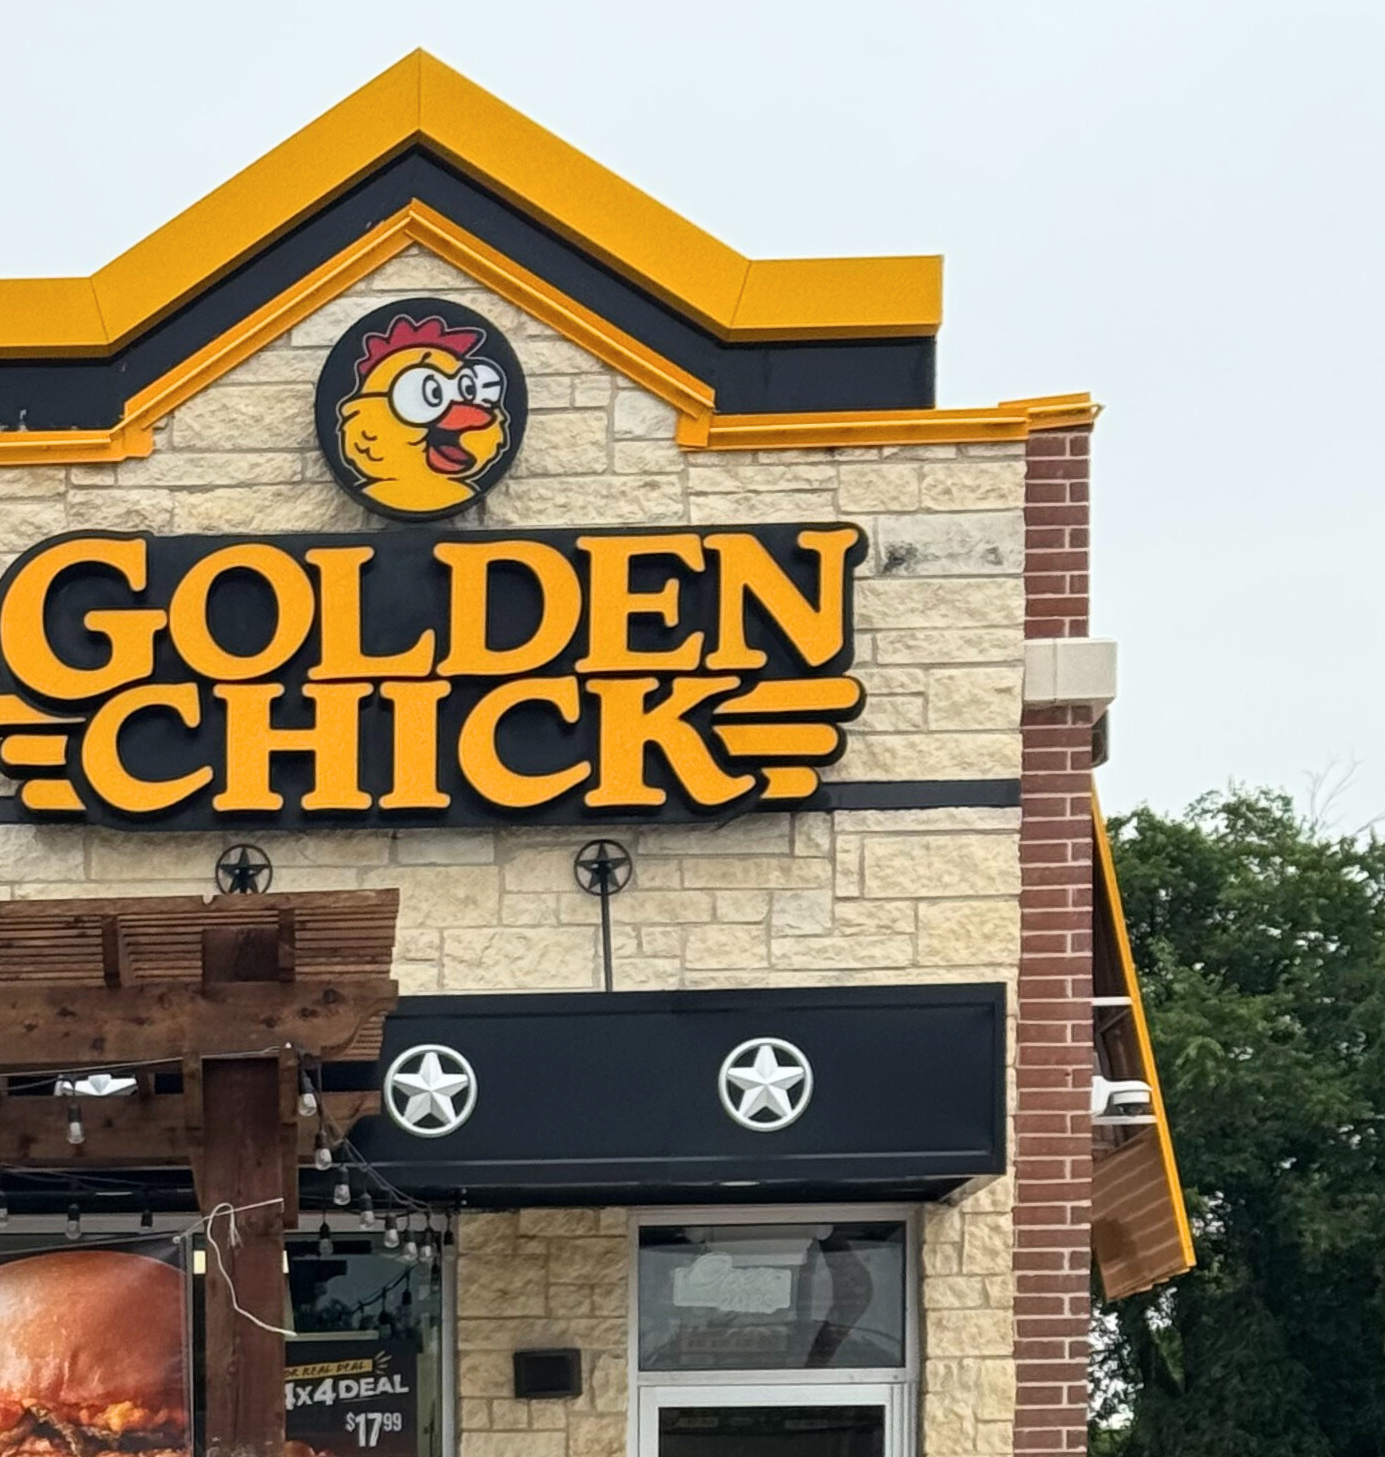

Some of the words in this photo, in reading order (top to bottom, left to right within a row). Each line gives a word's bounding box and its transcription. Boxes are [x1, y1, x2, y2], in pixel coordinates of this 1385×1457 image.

[0, 530, 858, 700] GOLDEN
[81, 676, 757, 813] CHICK
[337, 1373, 410, 1399] DEAL
